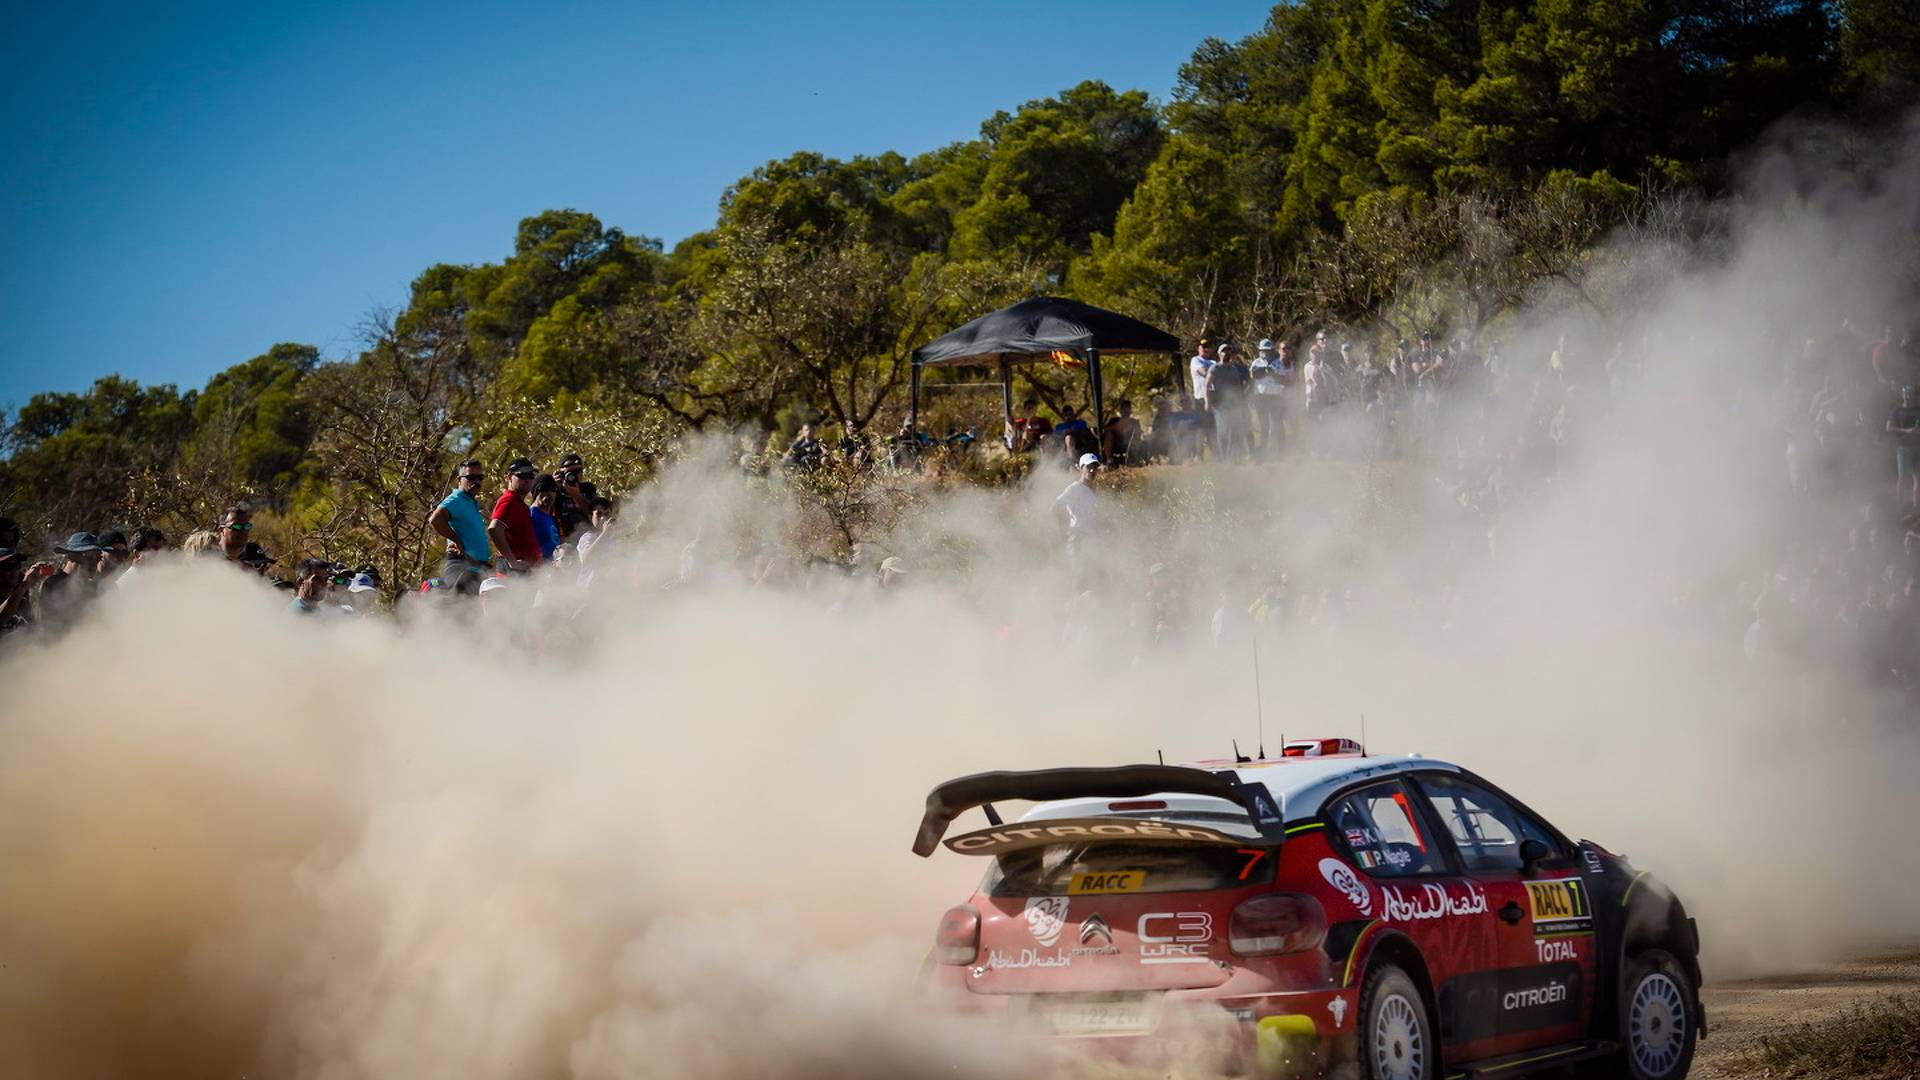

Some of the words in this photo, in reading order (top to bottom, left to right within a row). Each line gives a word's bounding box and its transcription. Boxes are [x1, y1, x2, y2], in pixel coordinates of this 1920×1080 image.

[1236, 849, 1265, 880] 7
[1081, 874, 1131, 891] RACC
[1531, 884, 1569, 916] RACC
[1138, 912, 1212, 943] C3
[1140, 944, 1208, 956] WRC
[1535, 940, 1577, 962] TOTAL
